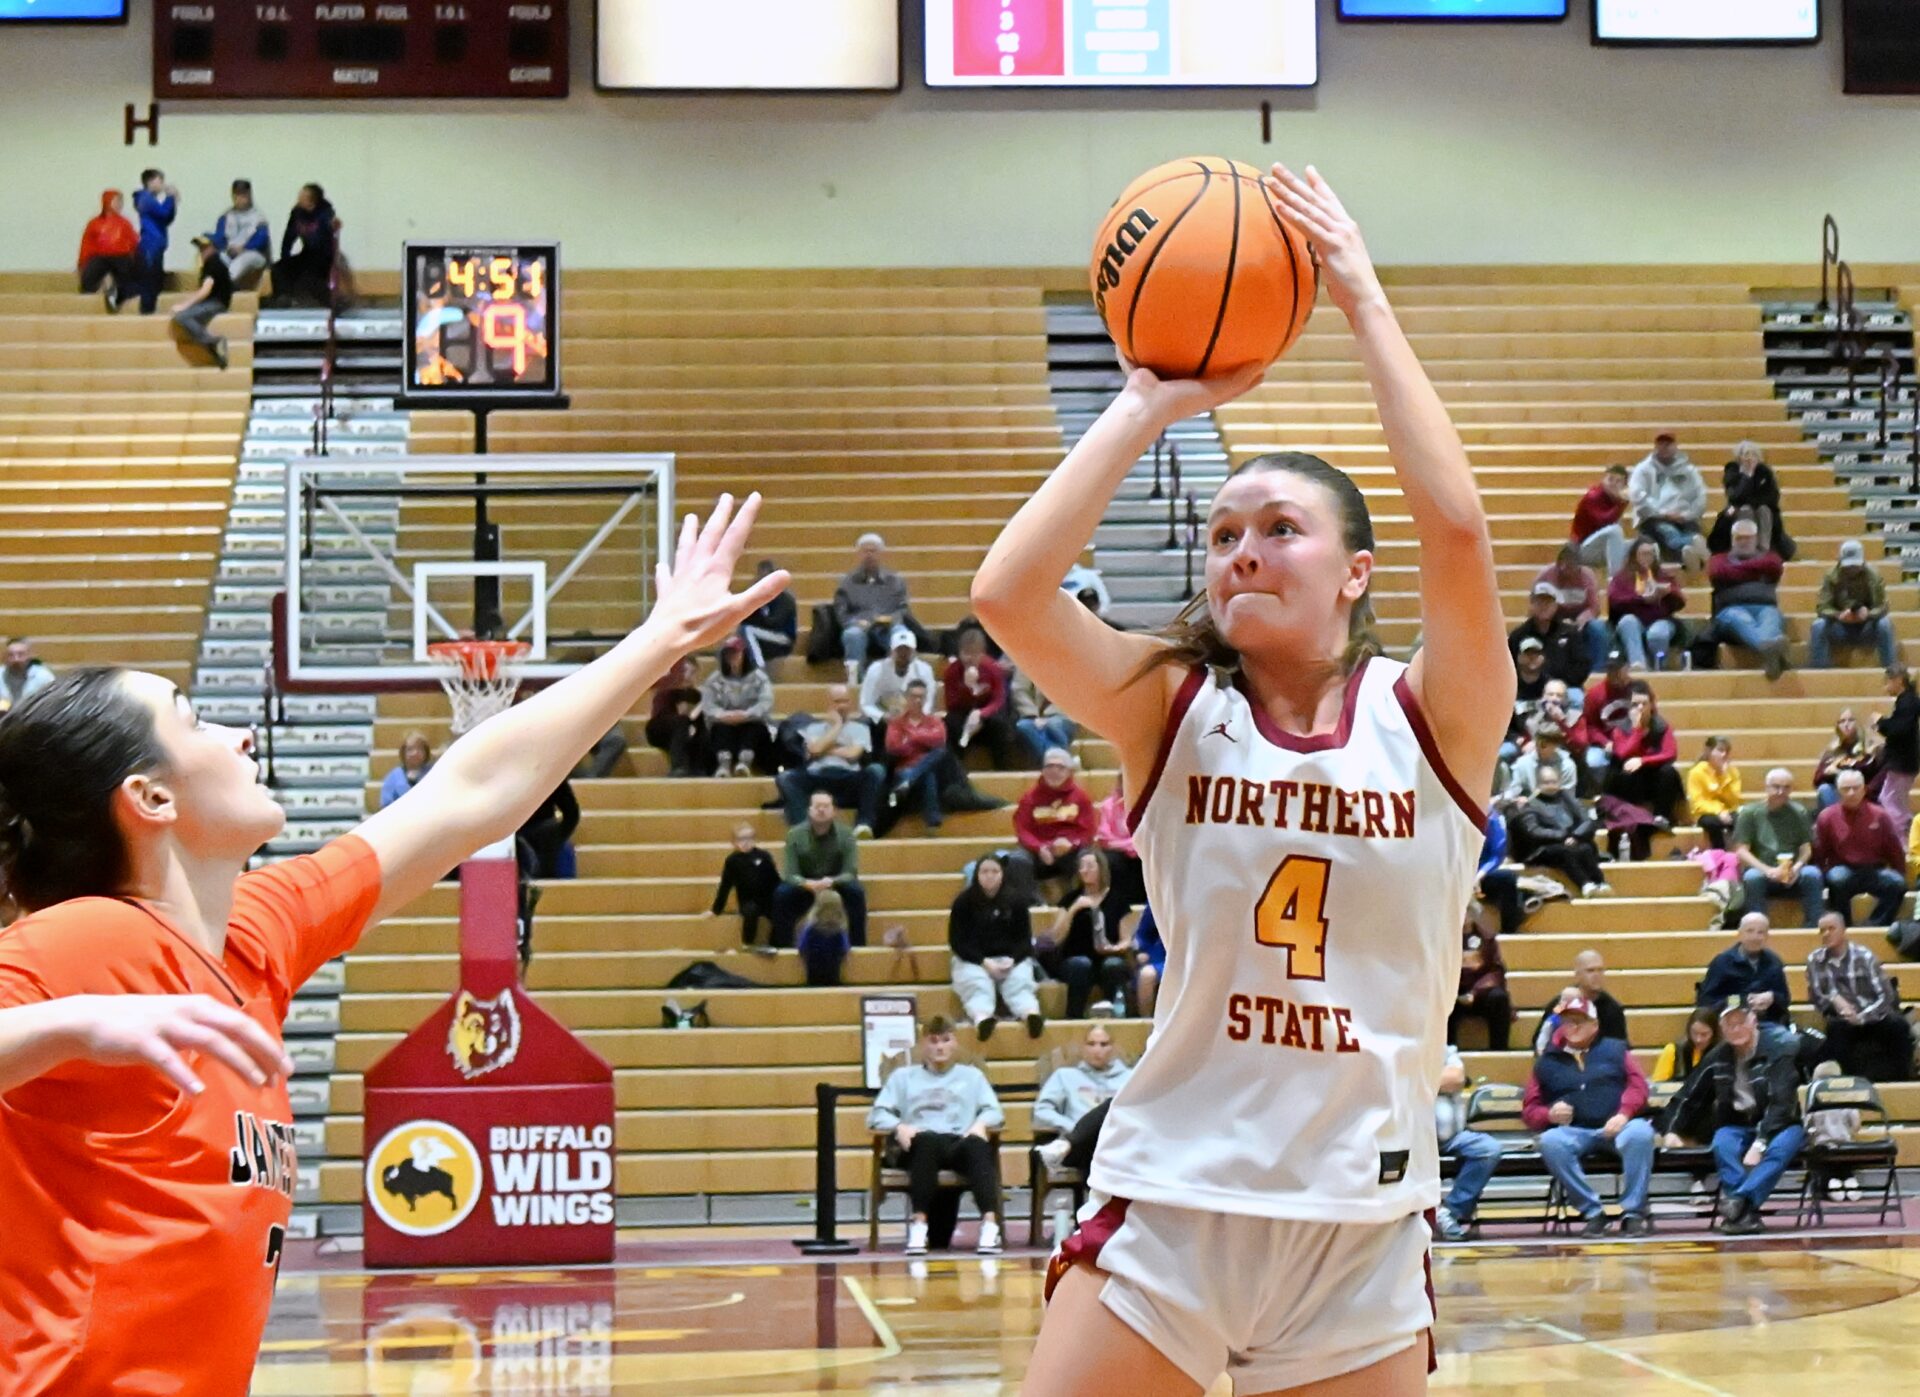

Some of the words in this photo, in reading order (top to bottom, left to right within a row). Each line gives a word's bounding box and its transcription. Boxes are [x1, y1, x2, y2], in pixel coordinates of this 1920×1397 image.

[125, 103, 159, 146] H
[449, 258, 542, 299] 4:51
[484, 303, 526, 376] 9
[1186, 776, 1415, 838] NORTHERN
[1254, 854, 1332, 981] 4
[1227, 994, 1360, 1052] STATE
[490, 1125, 612, 1151] BUFFALO
[490, 1151, 612, 1193] WILD
[490, 1192, 614, 1226] WINGS
